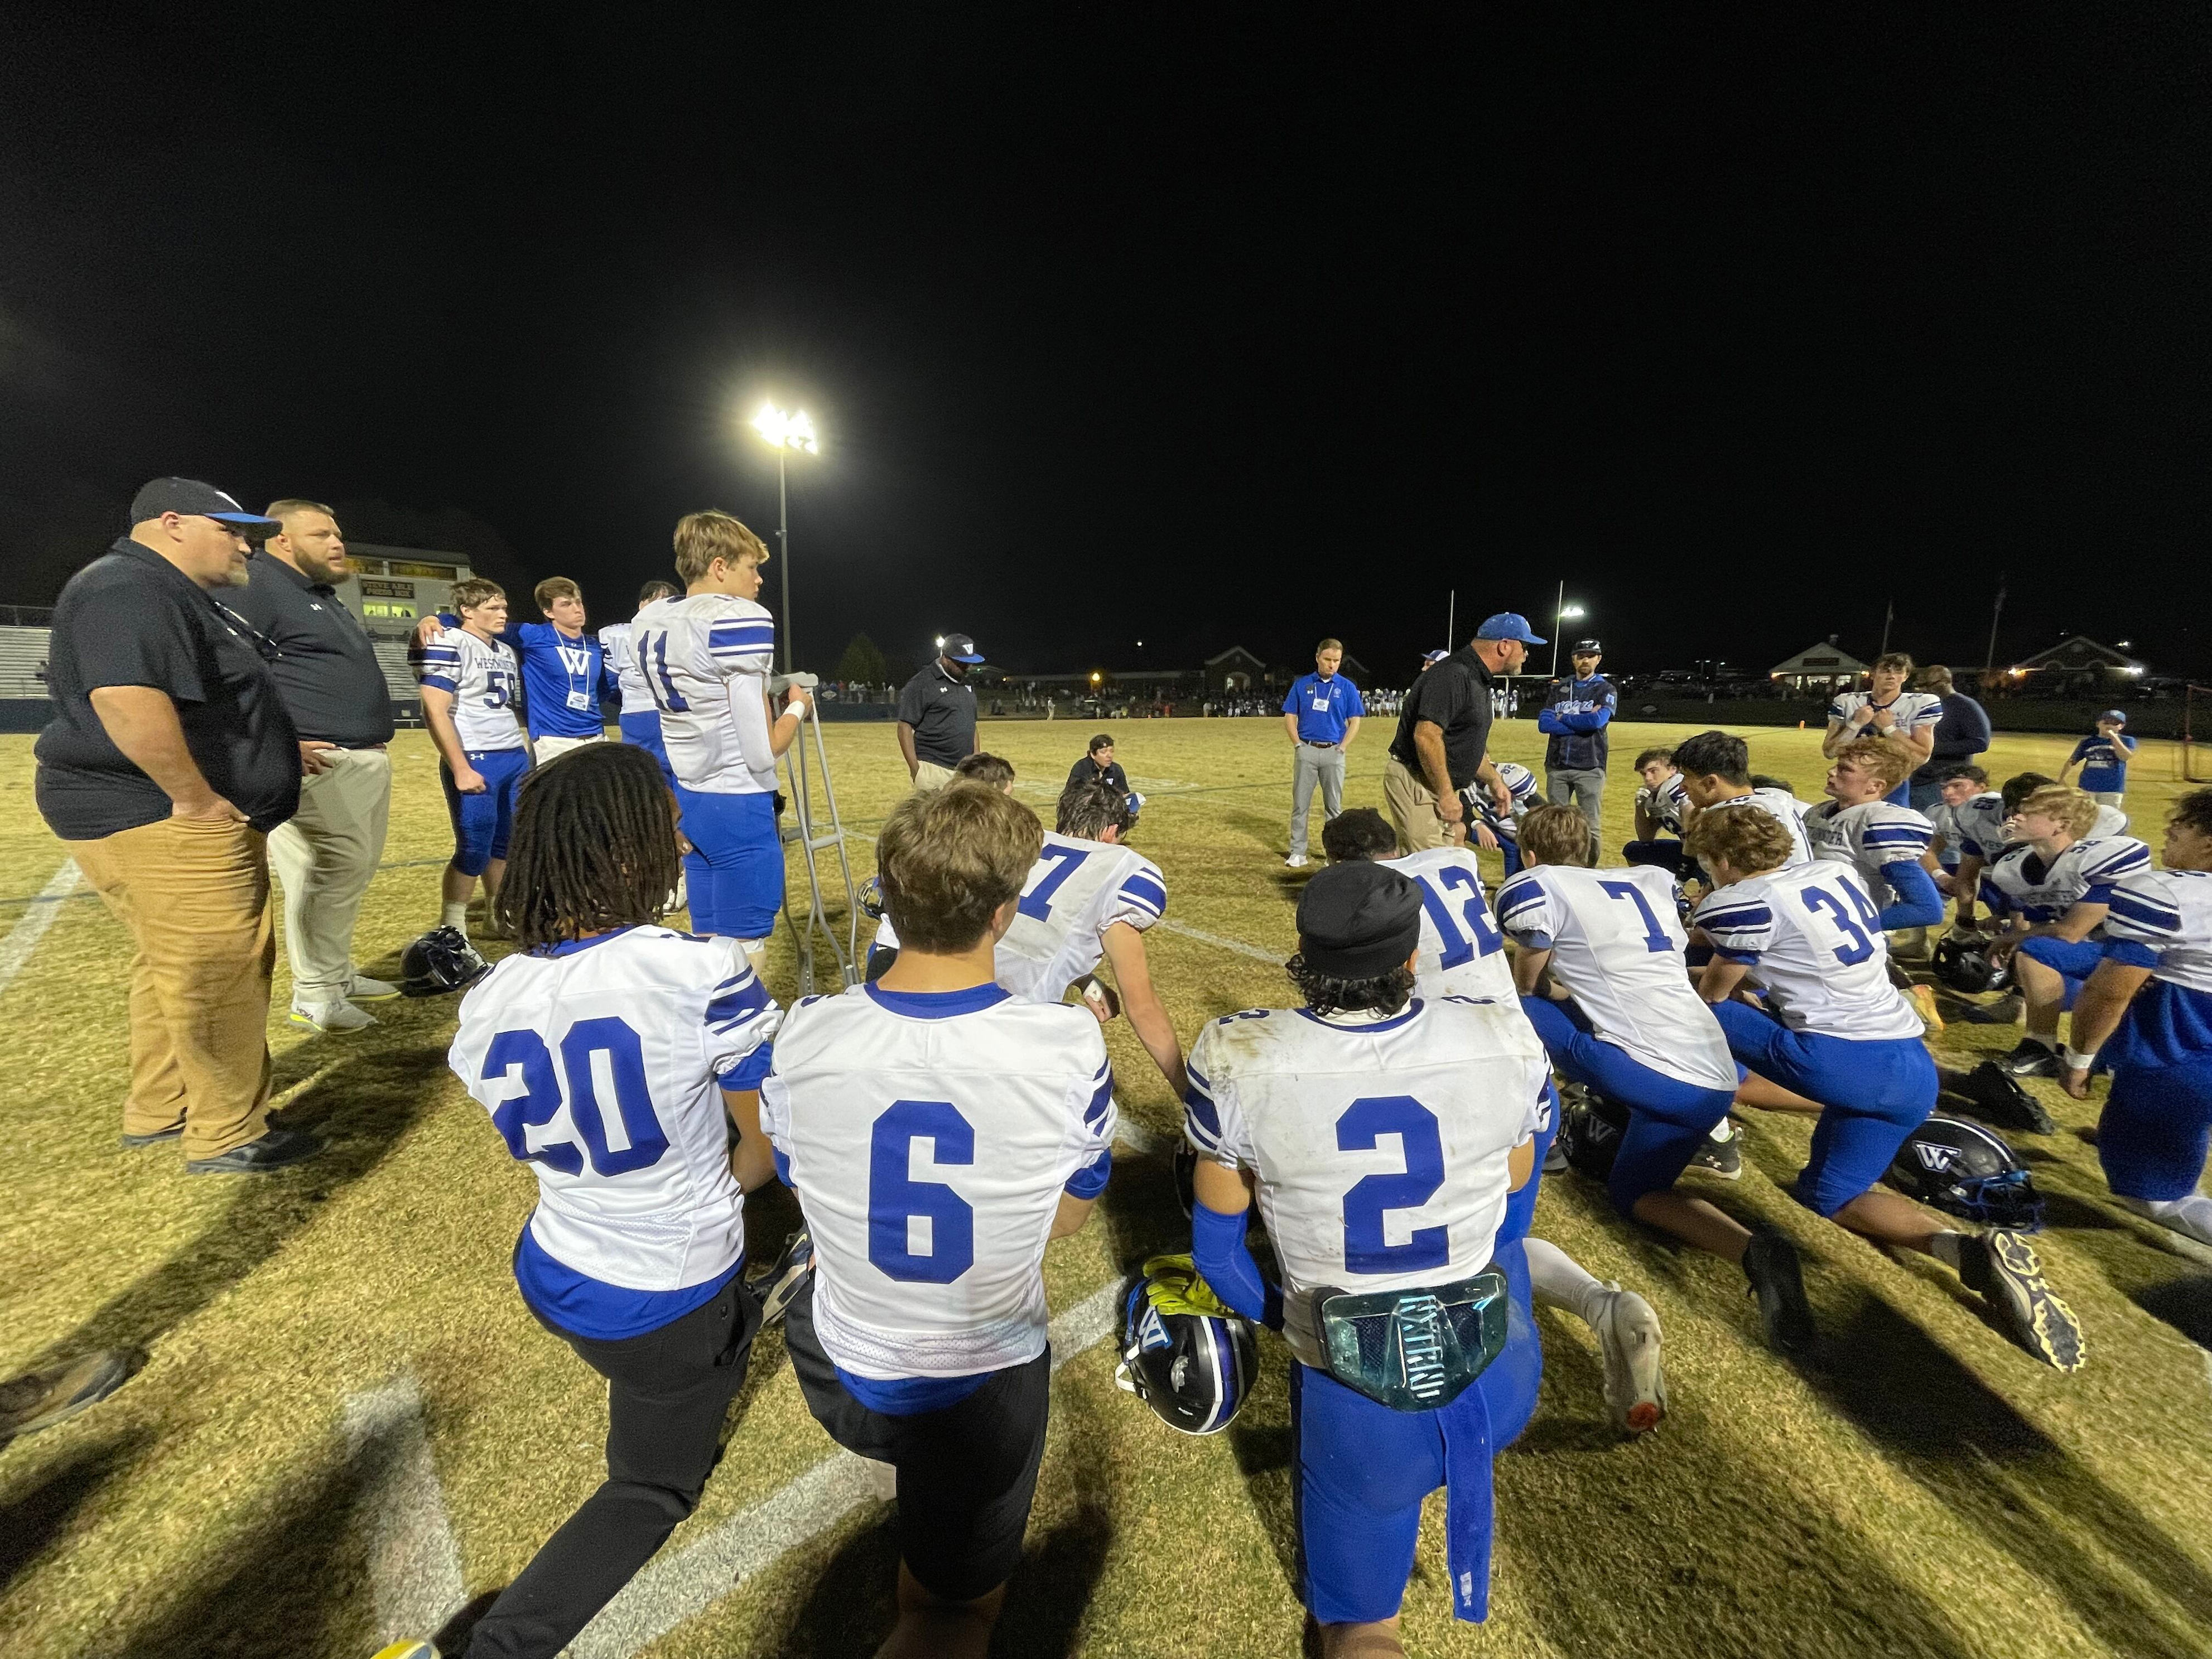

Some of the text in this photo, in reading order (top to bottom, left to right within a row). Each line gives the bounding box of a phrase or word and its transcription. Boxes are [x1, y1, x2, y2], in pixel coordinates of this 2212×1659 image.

[555, 646, 592, 676] W
[638, 630, 692, 713] 11
[1017, 843, 1091, 923] 7
[1413, 865, 1503, 971] 12
[1597, 880, 1675, 953] 7
[1800, 875, 1883, 967] 34
[480, 1016, 671, 1178] 20
[868, 1099, 975, 1285] 6
[1336, 1095, 1449, 1275] 2
